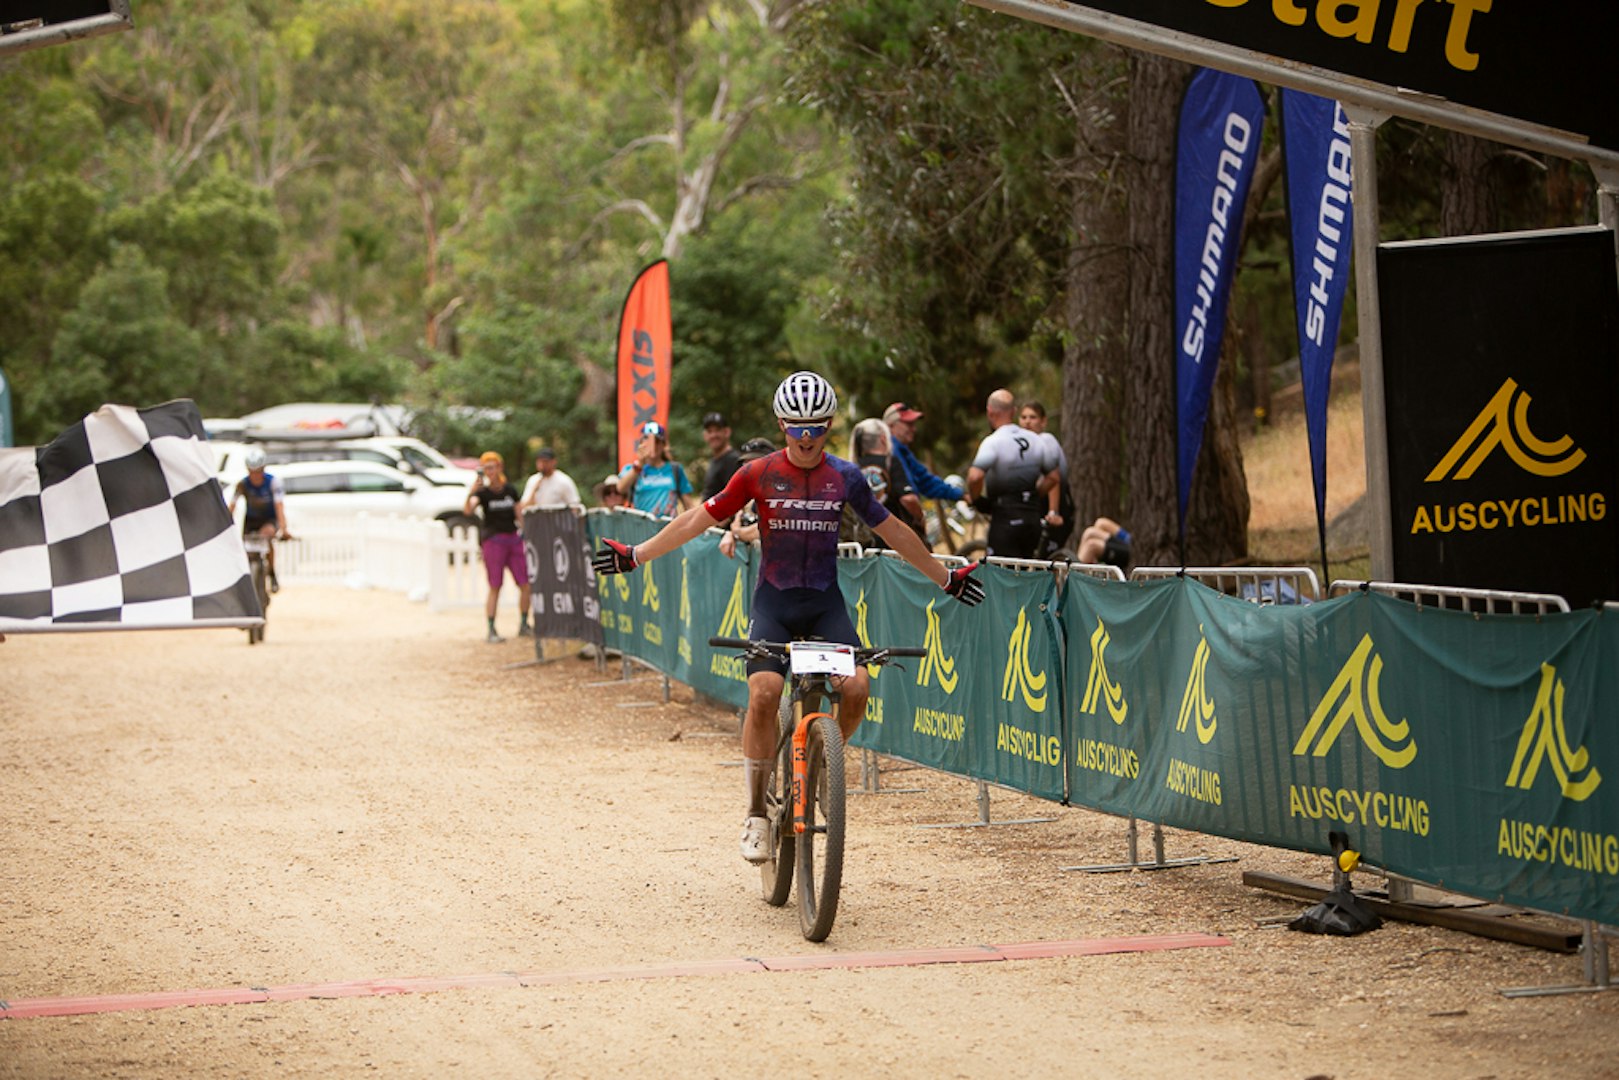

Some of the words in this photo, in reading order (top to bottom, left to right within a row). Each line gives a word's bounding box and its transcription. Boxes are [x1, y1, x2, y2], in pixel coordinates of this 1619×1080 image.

[1206, 0, 1493, 71] art
[1182, 112, 1250, 364] SHIMANO
[1304, 99, 1354, 347] SHIMA
[632, 328, 657, 453] XXIS
[765, 498, 843, 512] TREK
[768, 518, 839, 533] SHIMANO
[1410, 492, 1606, 535] AUSCYCLING
[710, 653, 748, 682] AUSCYCL
[1076, 737, 1140, 780] AUSCYCLING
[1165, 757, 1222, 807] AUSCYCLING
[1289, 784, 1431, 837] AUSCYCLING
[1497, 818, 1619, 876] AUSCYCLING
